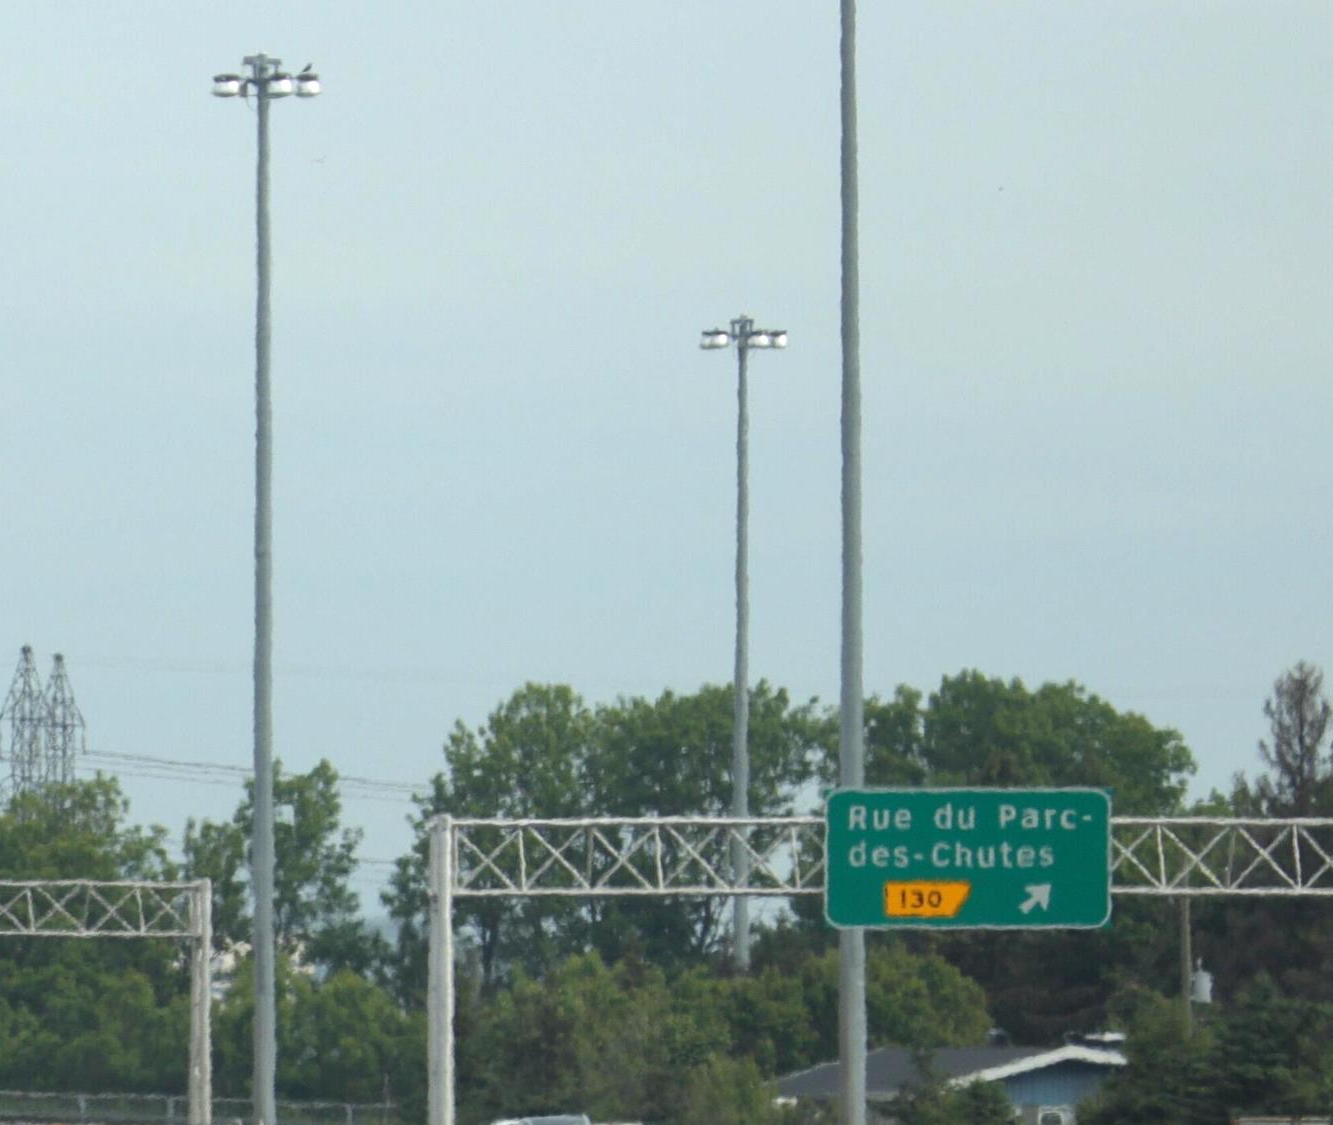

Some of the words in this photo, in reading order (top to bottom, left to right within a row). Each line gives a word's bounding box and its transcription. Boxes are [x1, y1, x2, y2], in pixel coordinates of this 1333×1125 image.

[848, 805, 912, 831] Rue
[934, 803, 976, 830] du
[998, 805, 1093, 830] Parc-
[848, 842, 1055, 868] des-Chutes
[899, 890, 943, 908] 130
